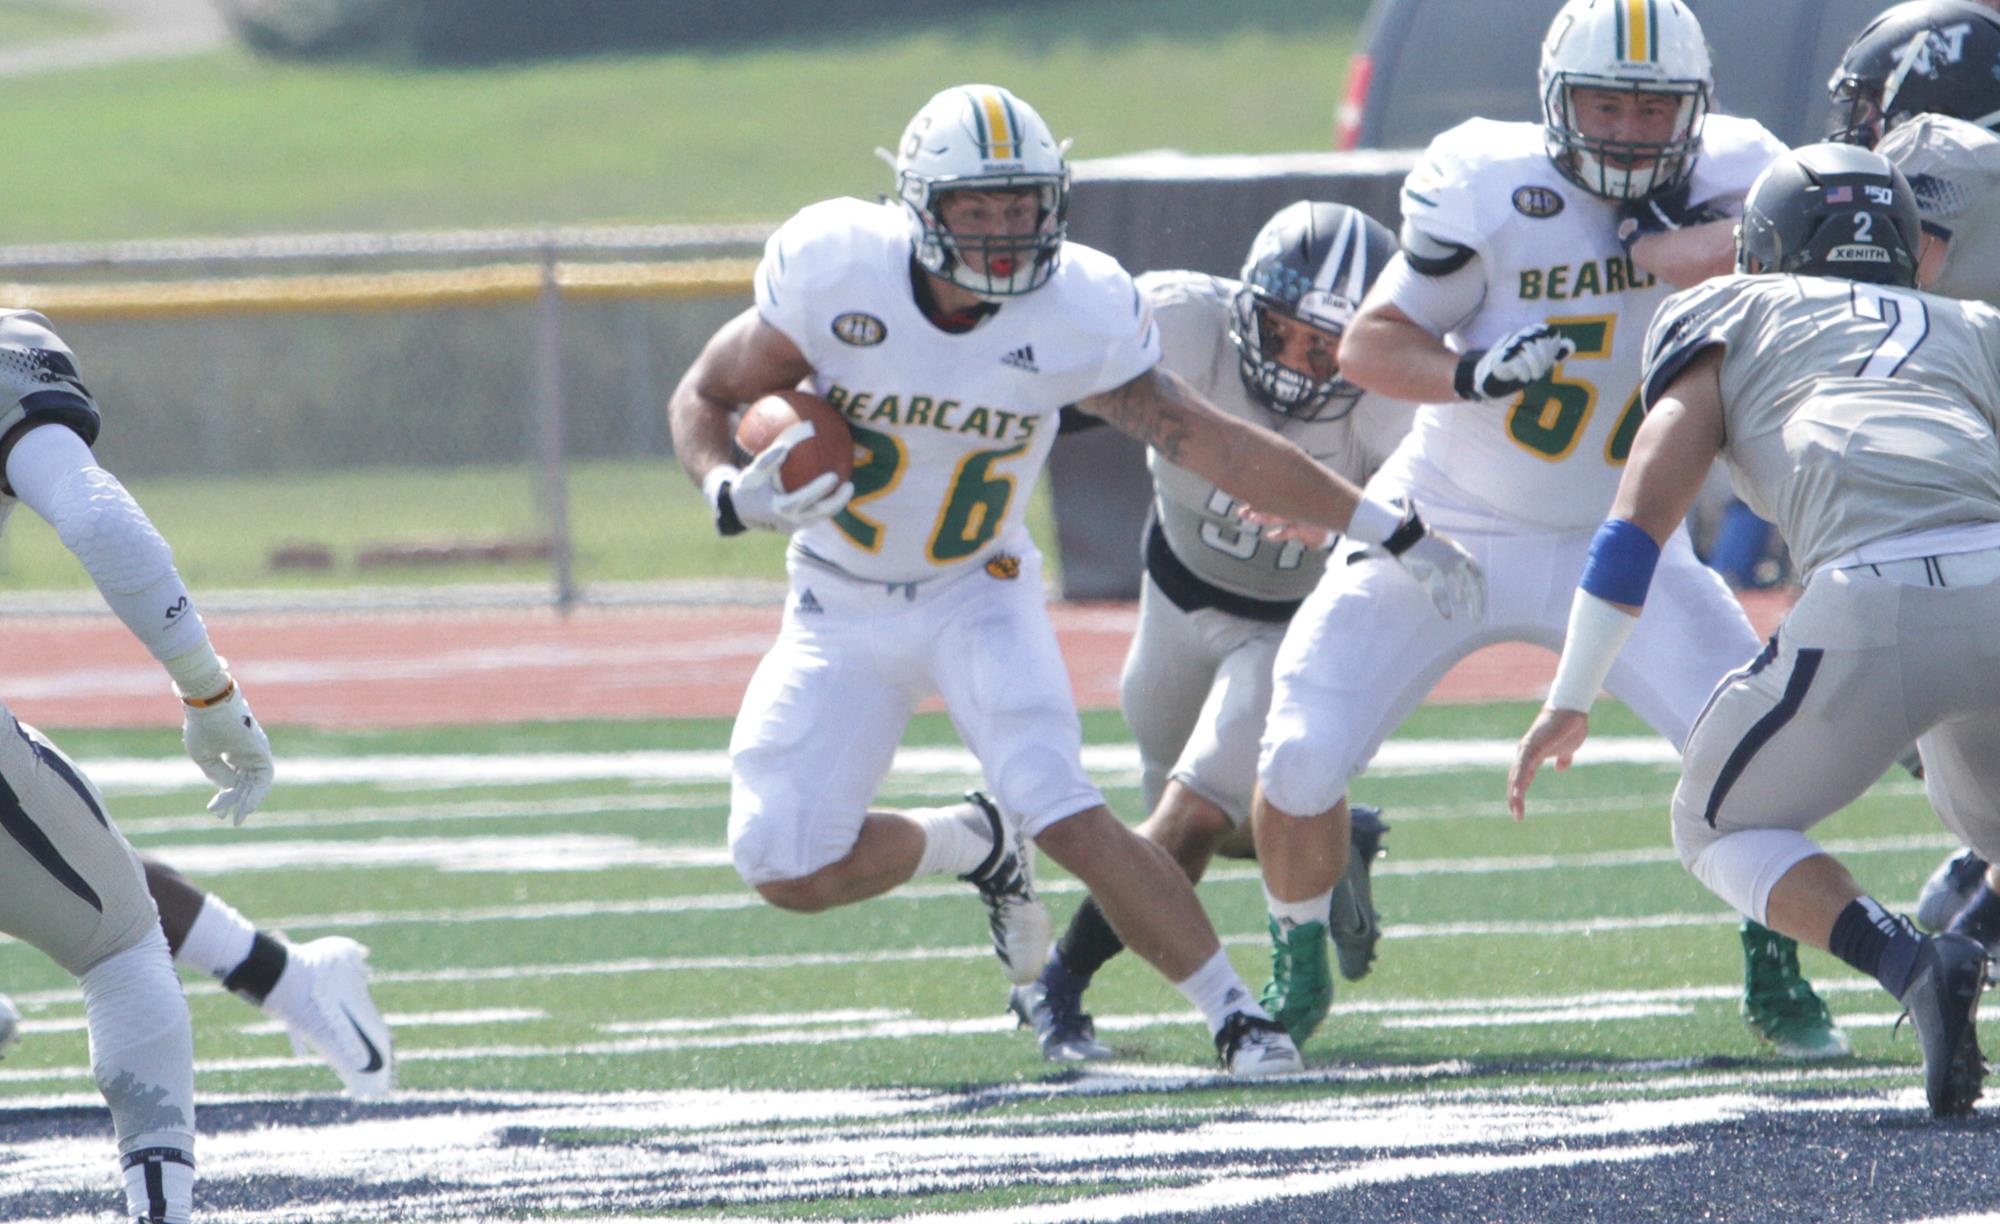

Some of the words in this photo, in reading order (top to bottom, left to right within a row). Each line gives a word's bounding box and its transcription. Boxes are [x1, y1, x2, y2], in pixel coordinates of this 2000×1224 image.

[1853, 210, 1873, 243] 2
[1518, 252, 1657, 301] BEARC
[1835, 248, 1886, 259] XENITH
[826, 382, 1041, 442] BEARCATS
[829, 424, 1034, 566] 26
